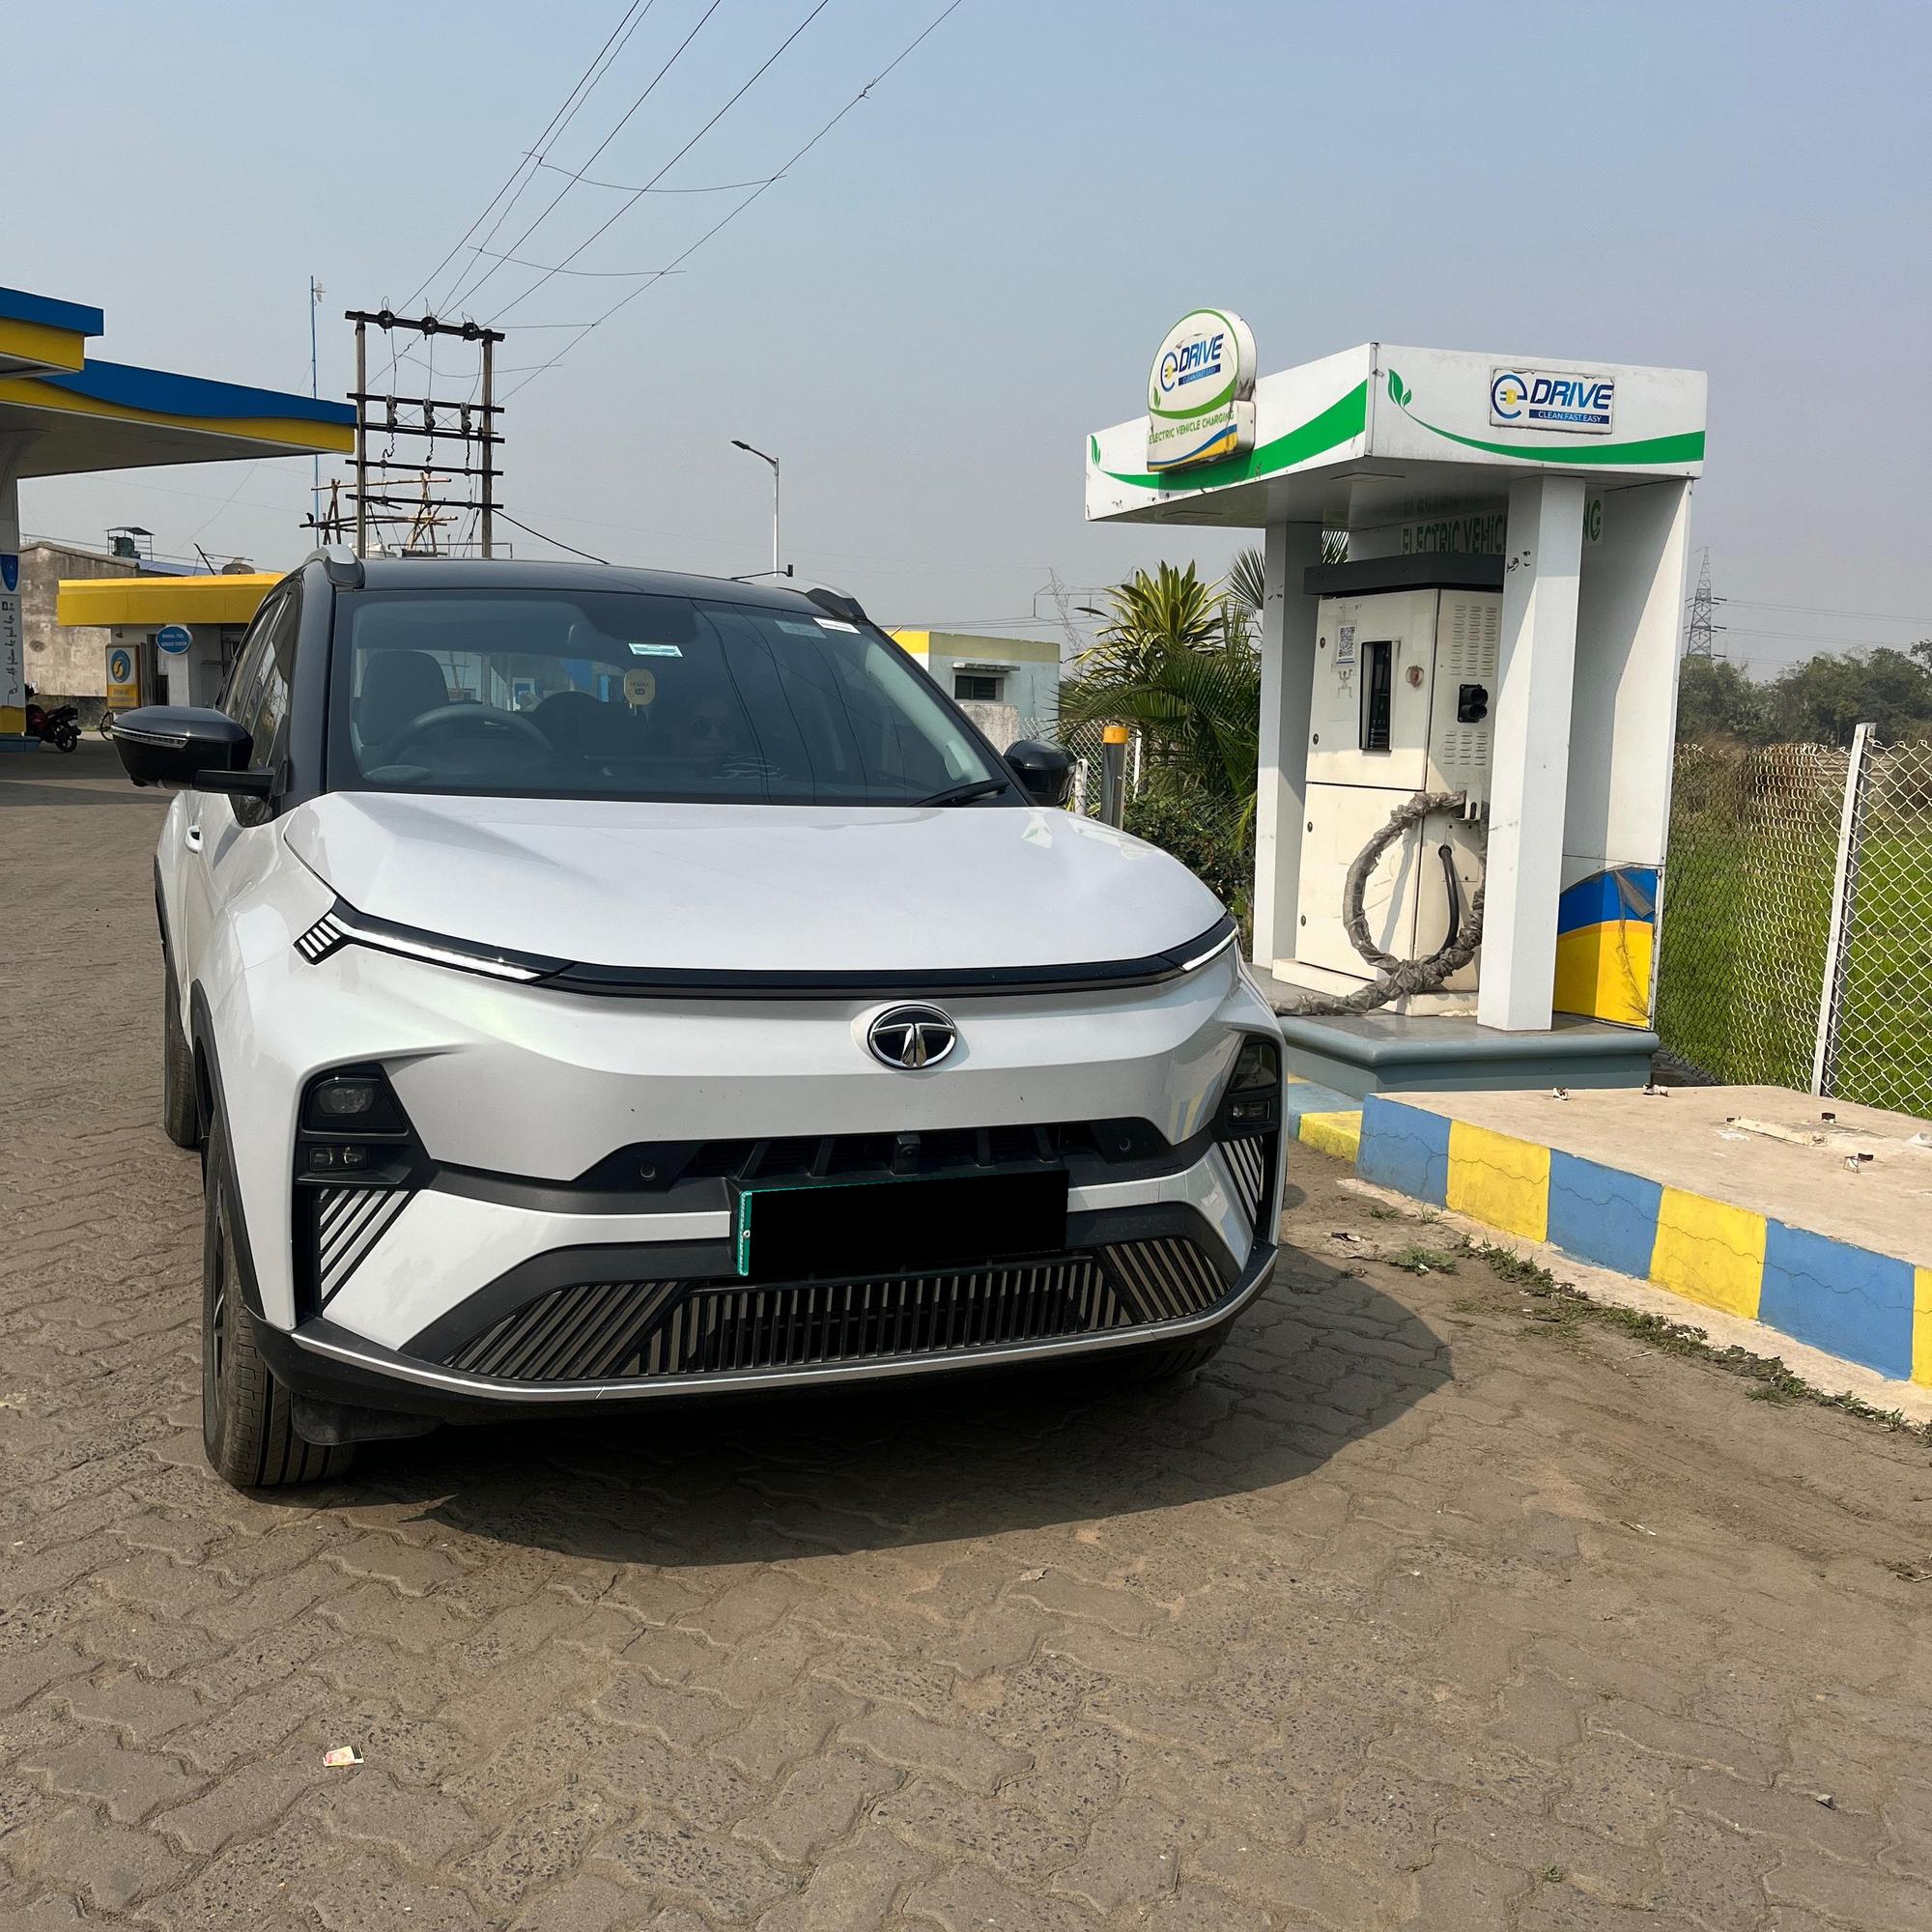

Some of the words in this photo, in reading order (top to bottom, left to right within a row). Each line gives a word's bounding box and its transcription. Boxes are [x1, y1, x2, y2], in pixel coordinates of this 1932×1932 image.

[1149, 428, 1175, 443] ELECTRIC
[1176, 420, 1201, 435] VEHICLE
[1202, 412, 1234, 428] CHARGING
[1403, 520, 1461, 554] ELECTRIC
